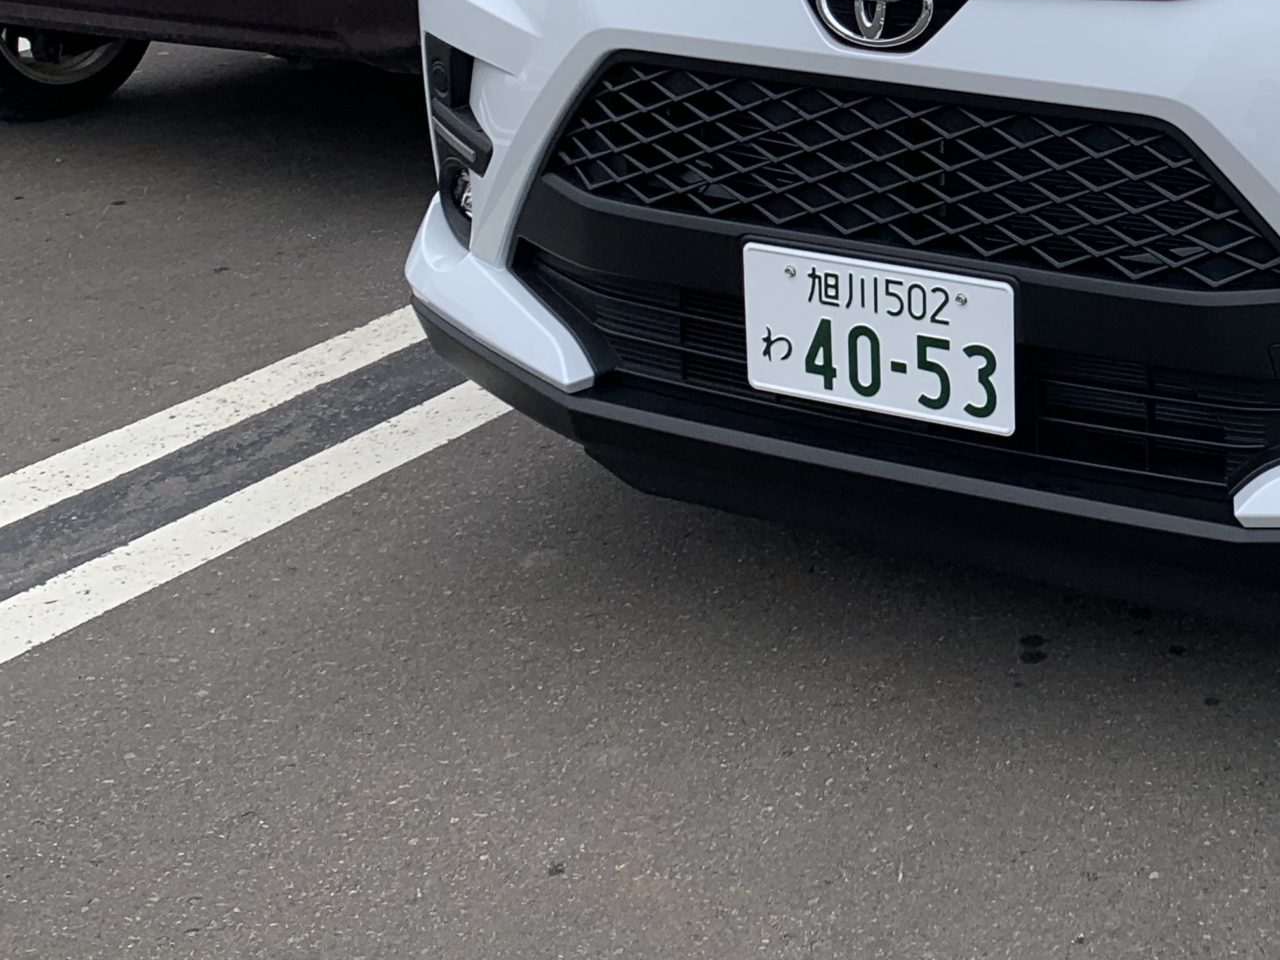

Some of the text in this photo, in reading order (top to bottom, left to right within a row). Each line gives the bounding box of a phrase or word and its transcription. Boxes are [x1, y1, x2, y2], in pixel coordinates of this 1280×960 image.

[807, 267, 950, 325] 旭川502
[762, 318, 998, 419] わ 40-53
